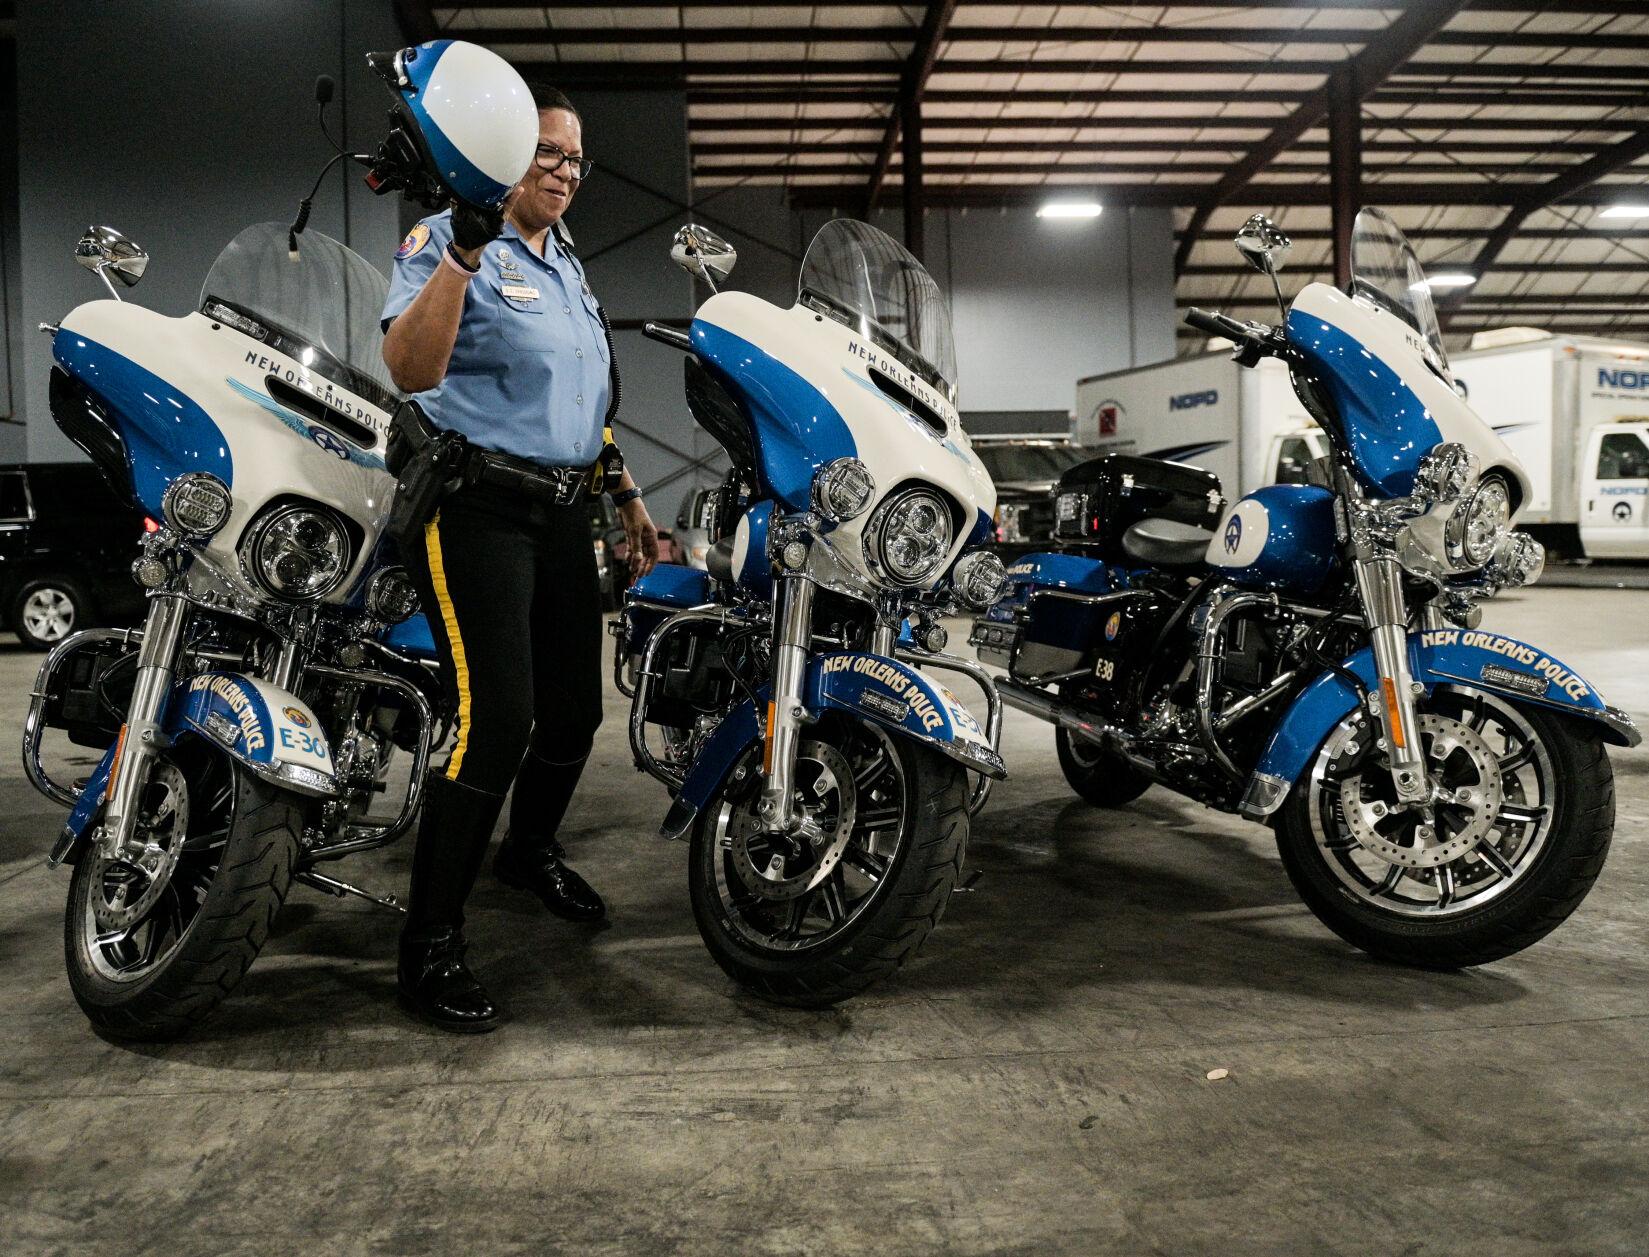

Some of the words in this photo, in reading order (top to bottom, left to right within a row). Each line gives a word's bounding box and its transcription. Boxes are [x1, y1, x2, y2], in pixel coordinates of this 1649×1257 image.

[245, 350, 281, 375] NEW
[285, 370, 352, 414] OREANS
[356, 408, 392, 438] POLIC
[848, 341, 877, 364] NEW
[881, 360, 930, 403] ORLEANS
[823, 655, 853, 674] NEW
[854, 656, 910, 693] ORLEANS
[903, 684, 944, 733] POLICE
[1421, 631, 1460, 648] NEW
[1462, 631, 1539, 665] ORLEANS
[1534, 657, 1590, 701] POLICE
[189, 674, 216, 693] NEW
[210, 675, 249, 713] ORLEANS
[238, 704, 265, 755] POLICE
